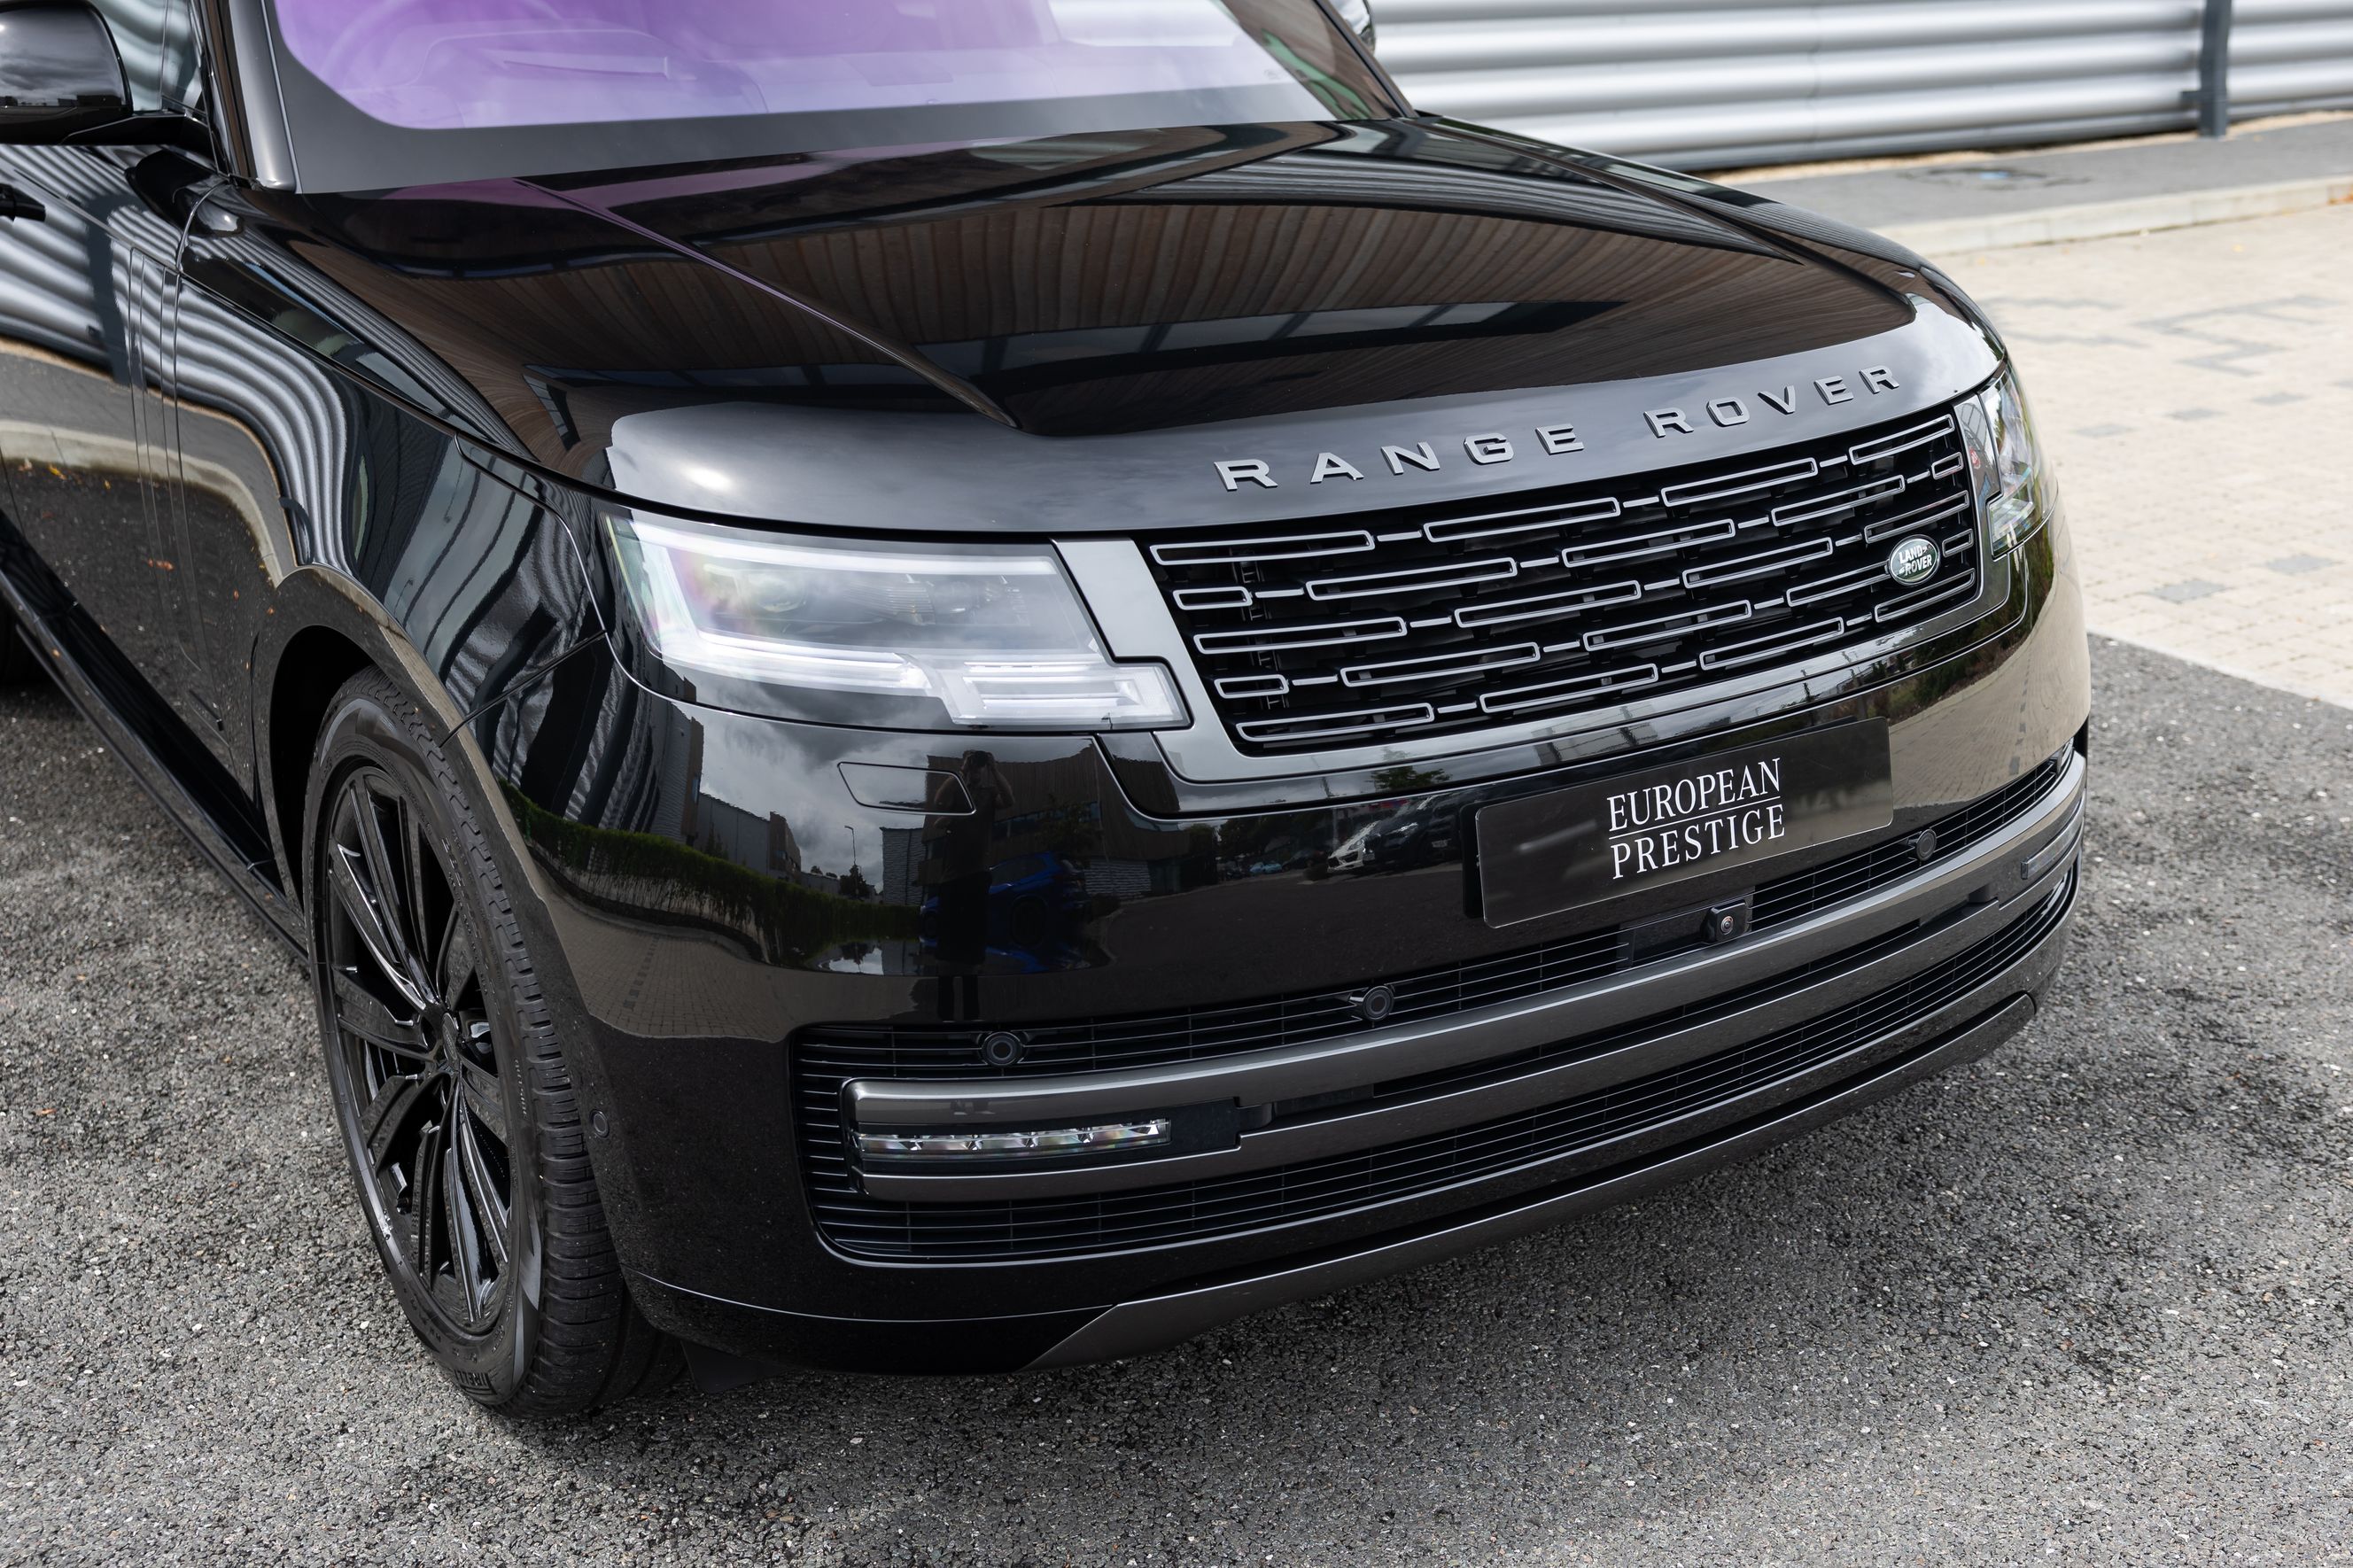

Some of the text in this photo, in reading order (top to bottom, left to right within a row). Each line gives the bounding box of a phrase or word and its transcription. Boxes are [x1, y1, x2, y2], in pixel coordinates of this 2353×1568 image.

[1213, 364, 1901, 492] RANGE ROVER
[1899, 545, 1923, 564] LAND
[1905, 554, 1932, 576] ROVER
[1606, 757, 1782, 833] EUROPEAN
[1610, 804, 1786, 880] PRESTIGE
